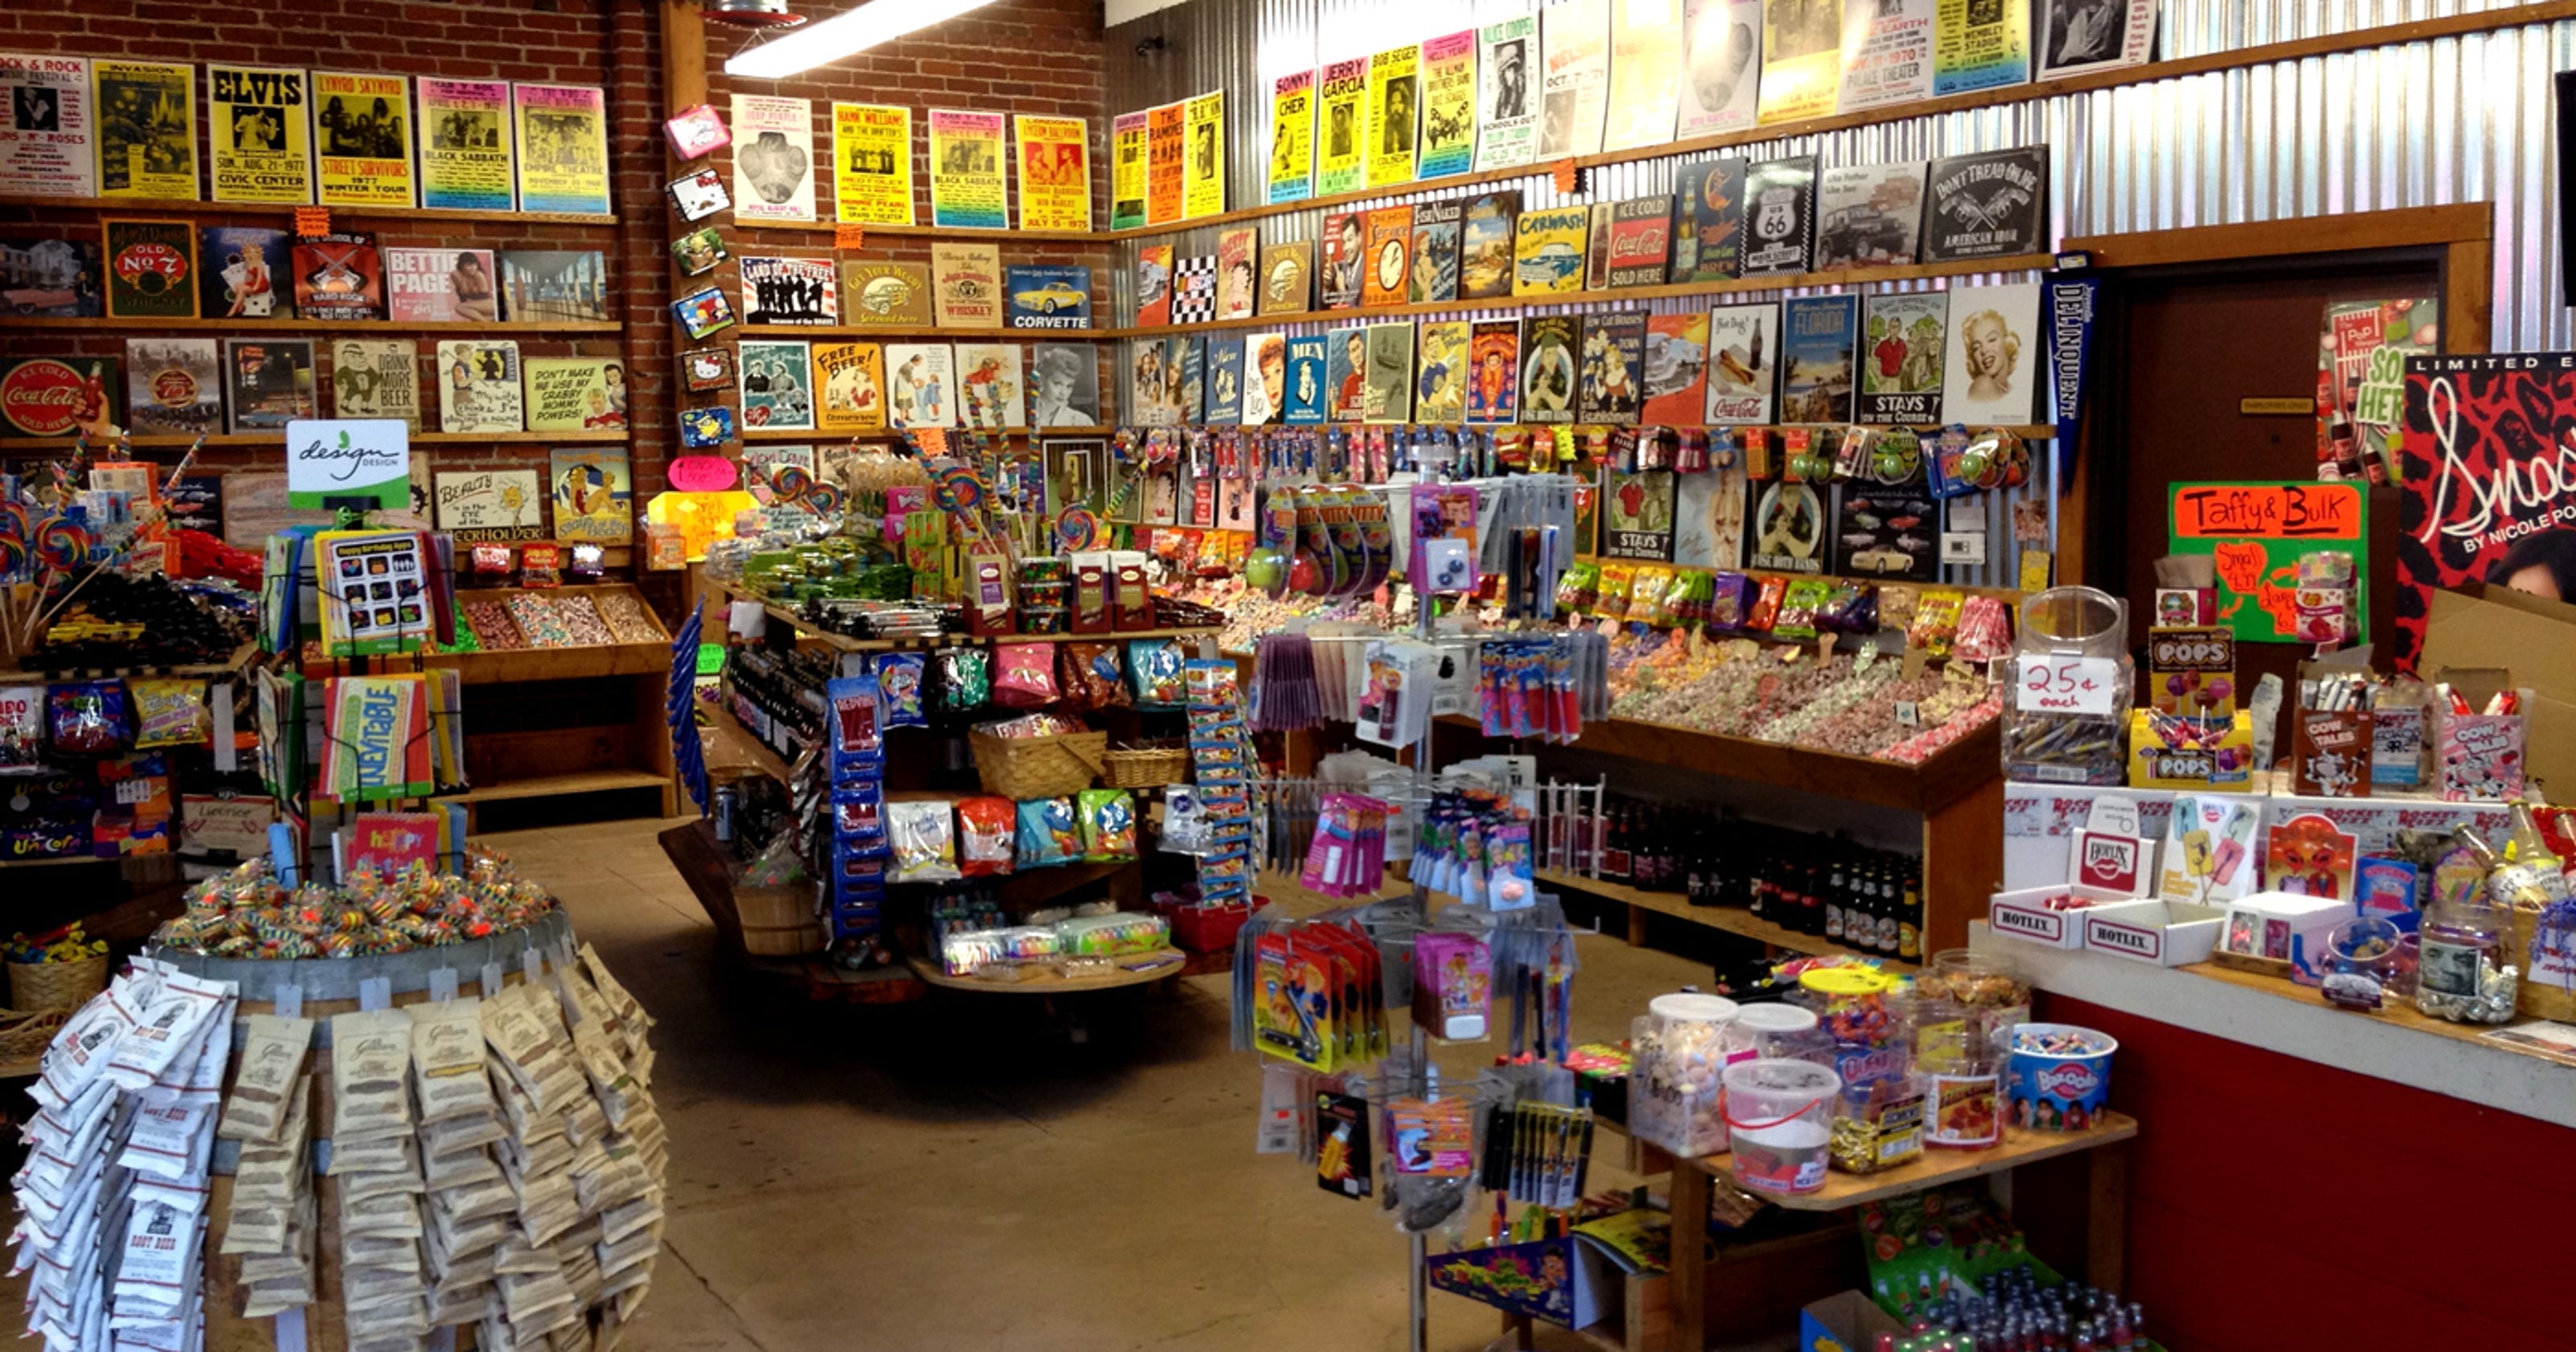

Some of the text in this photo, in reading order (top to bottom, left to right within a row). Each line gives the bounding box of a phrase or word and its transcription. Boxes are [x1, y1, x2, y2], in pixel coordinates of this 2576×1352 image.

[1881, 18, 1930, 34] EARTH
[1963, 25, 2004, 40] WEMBLEY
[1964, 36, 2004, 52] STADIUM
[1373, 46, 1418, 68] BOB SEGER
[1889, 49, 1916, 65] 1970
[30, 60, 39, 71] &
[45, 60, 82, 72] ROCK
[110, 64, 175, 74] INVASION
[1327, 57, 1365, 81] JERRY
[213, 70, 301, 105] ELVIS
[1275, 71, 1311, 96] SONNY
[1323, 77, 1366, 98] GARCIA
[1160, 109, 1177, 122] THE
[1278, 97, 1306, 117] CHER
[47, 134, 85, 144] ROSES
[1150, 122, 1185, 141] RAMONES
[425, 150, 508, 163] BLACK SABBATH
[218, 174, 304, 186] CIVIC CENTER
[935, 175, 1002, 186] BLACK SABBATH
[1827, 171, 1869, 183] Like Father
[1968, 163, 2003, 183] TREAD
[1618, 200, 1665, 217] ICE COLD
[1026, 219, 1048, 227] JULY
[1068, 220, 1088, 228] 1975
[1518, 211, 1587, 236] CARWASH
[1764, 215, 1786, 235] 66
[1944, 232, 1992, 248] AMERICAN
[136, 245, 165, 254] OLD
[159, 257, 179, 274] 7
[392, 273, 451, 295] PAGE
[1612, 267, 1662, 286] SOLD HERE
[945, 304, 993, 317] WHISKEY
[1014, 316, 1088, 329] CORVETTE
[817, 345, 857, 372] FREE
[1291, 341, 1325, 362] MEN
[2053, 282, 2084, 419] DELINQUENT
[378, 354, 412, 372] DRINK
[828, 349, 875, 381] BEER!
[2369, 347, 2405, 384] SO
[2417, 357, 2539, 371] LIMITED
[19, 365, 70, 380] ICE COLD
[380, 372, 412, 389] MORE
[535, 367, 595, 381] DON'T MAKE
[535, 378, 592, 391] ME USE MY
[541, 390, 582, 402] CRABBY
[1876, 395, 1926, 412] STAYS
[2359, 385, 2404, 422] HER
[542, 400, 581, 410] MOMMY
[535, 408, 584, 421] POWERS!
[299, 440, 400, 481] design
[362, 459, 398, 467] DESIGN
[2184, 485, 2347, 531] Taffy & Bulk
[1620, 533, 1658, 546] STAYS
[2463, 535, 2485, 554] BY
[2488, 514, 2551, 545] NICOLE
[2219, 543, 2261, 571] Small
[2157, 644, 2228, 662] POPS
[2039, 695, 2080, 708] each
[2308, 720, 2343, 736] COW
[2456, 723, 2495, 742] COW
[2314, 731, 2355, 748] TALES
[2160, 757, 2211, 776] POPS
[198, 806, 252, 818] Licorice
[2398, 809, 2459, 825] ROCKET
[2002, 911, 2050, 934] HOTLIX
[2097, 927, 2147, 949] HOTLIX
